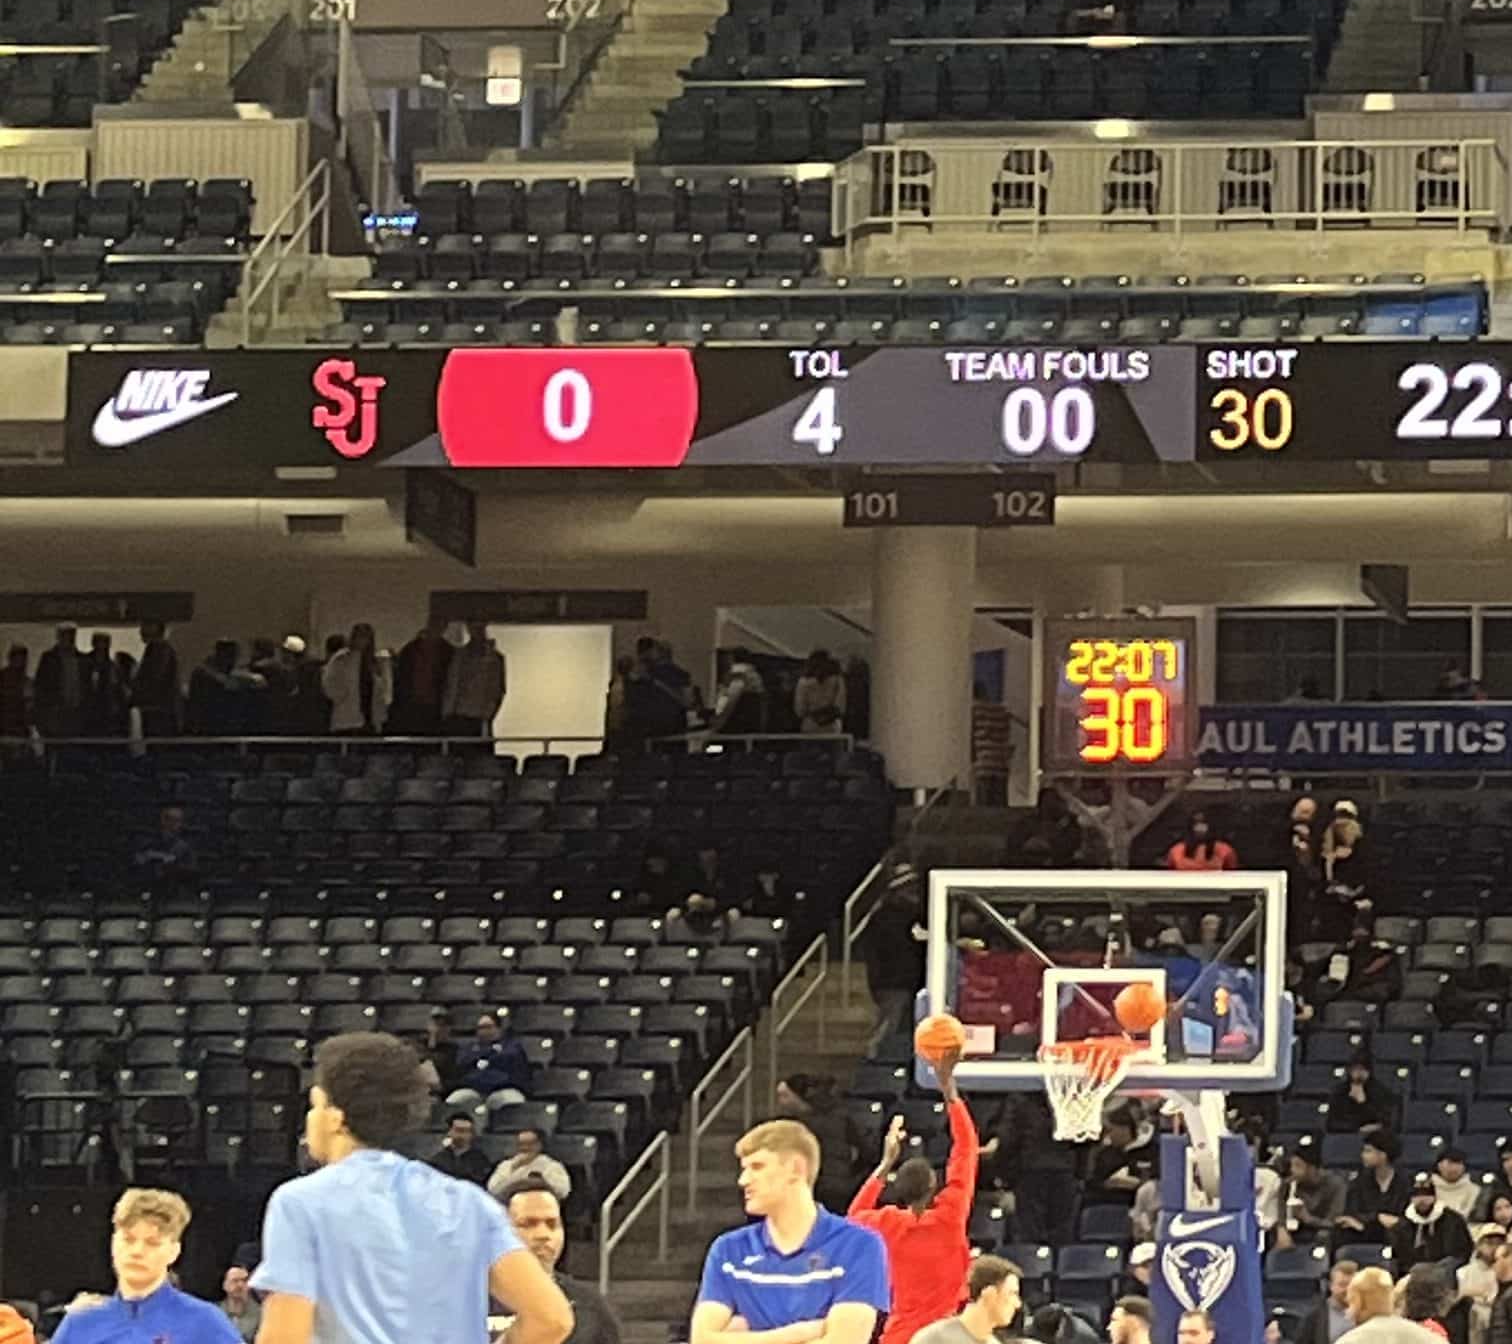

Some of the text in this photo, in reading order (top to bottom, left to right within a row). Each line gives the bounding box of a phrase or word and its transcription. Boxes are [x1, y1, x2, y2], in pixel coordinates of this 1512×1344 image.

[789, 350, 849, 379] TOL
[945, 350, 1150, 381] TEAM FOULS
[1206, 348, 1299, 379] SHOT
[115, 369, 211, 416] NIKE
[542, 368, 593, 443] 0
[792, 386, 842, 455] 4
[1002, 386, 1097, 455] 00
[1209, 388, 1294, 451] 30
[851, 492, 898, 518] 101
[994, 491, 1046, 518] 102
[1065, 639, 1177, 684] 22:07
[1079, 687, 1168, 763] 30
[1196, 720, 1277, 754] AUL
[1286, 719, 1507, 754] ATHLETICS
